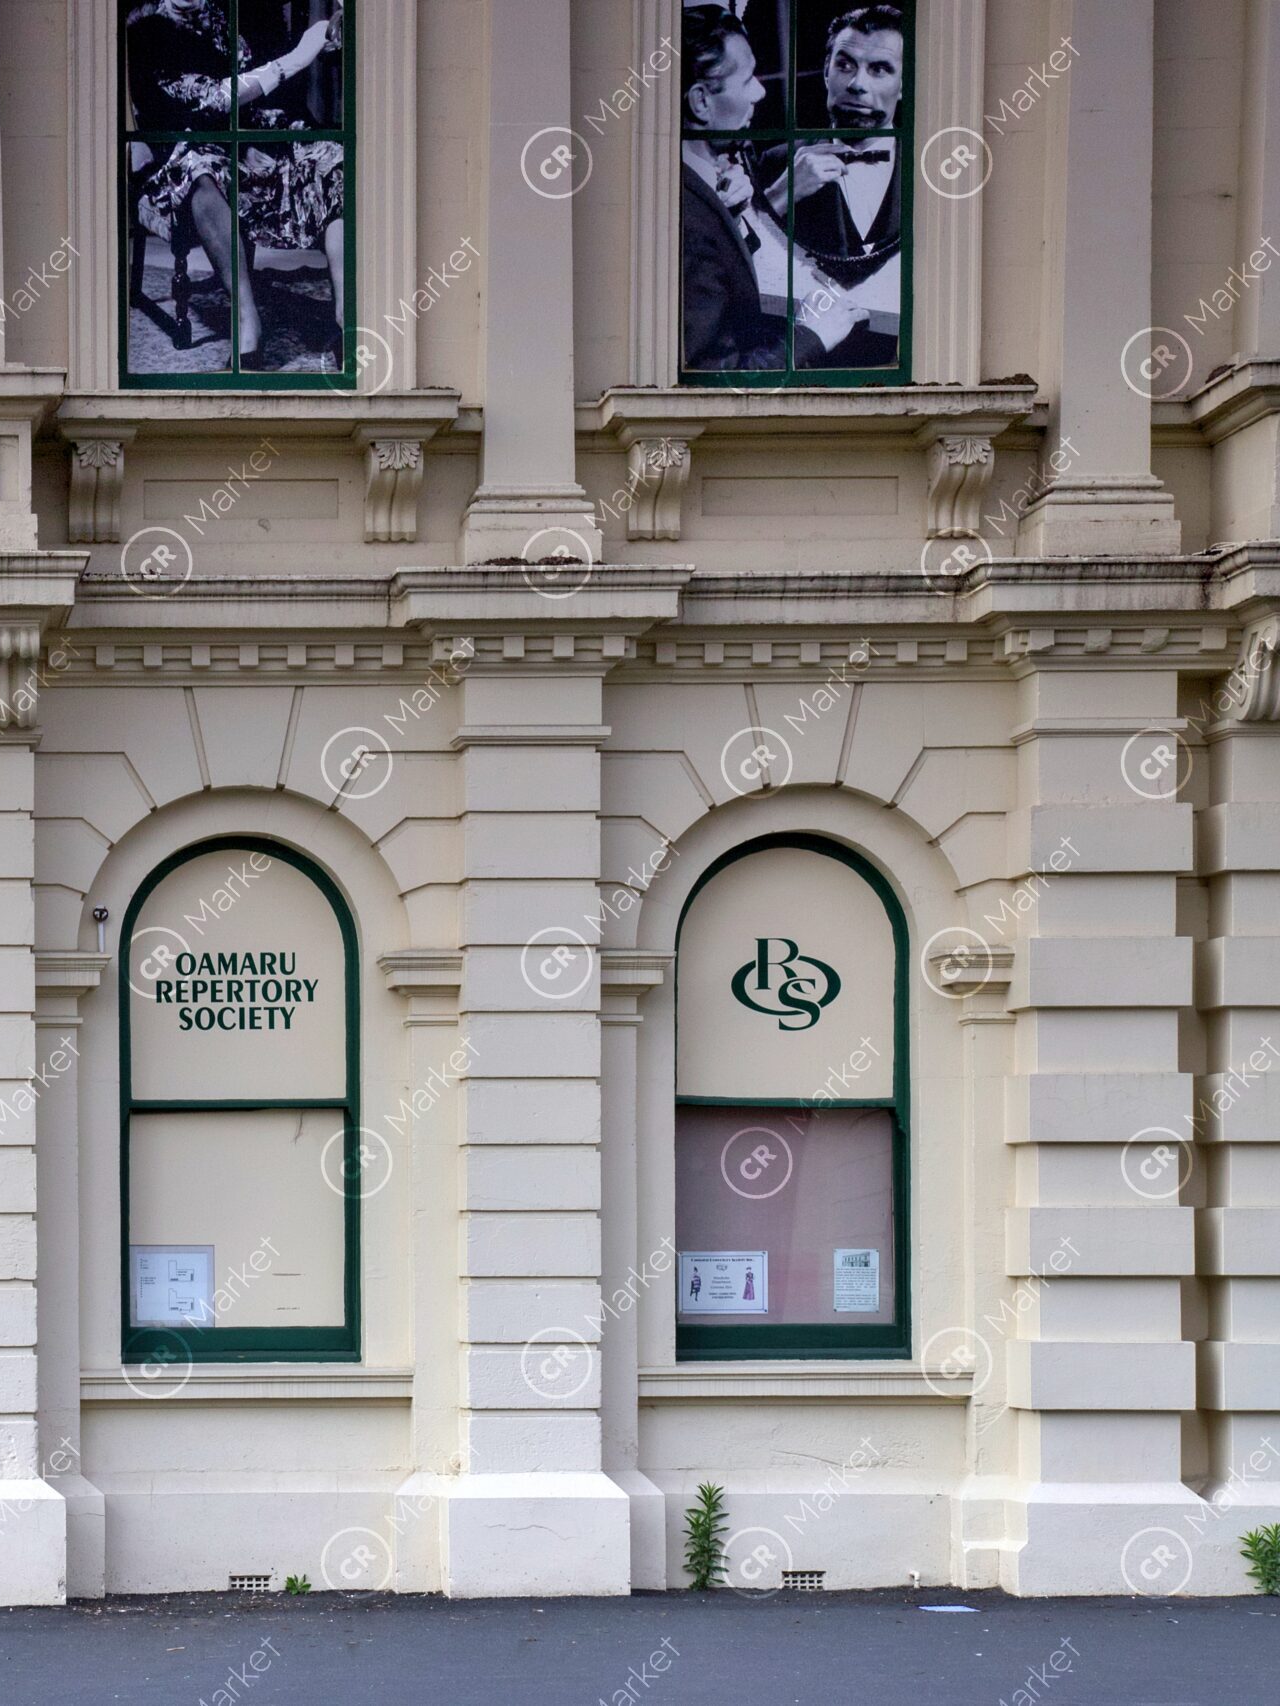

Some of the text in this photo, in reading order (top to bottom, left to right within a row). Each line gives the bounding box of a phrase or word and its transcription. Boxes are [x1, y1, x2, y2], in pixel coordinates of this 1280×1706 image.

[175, 952, 296, 976] OAMARU
[156, 979, 319, 1003] REPERTORY
[179, 1006, 296, 1031] SOCIETY
